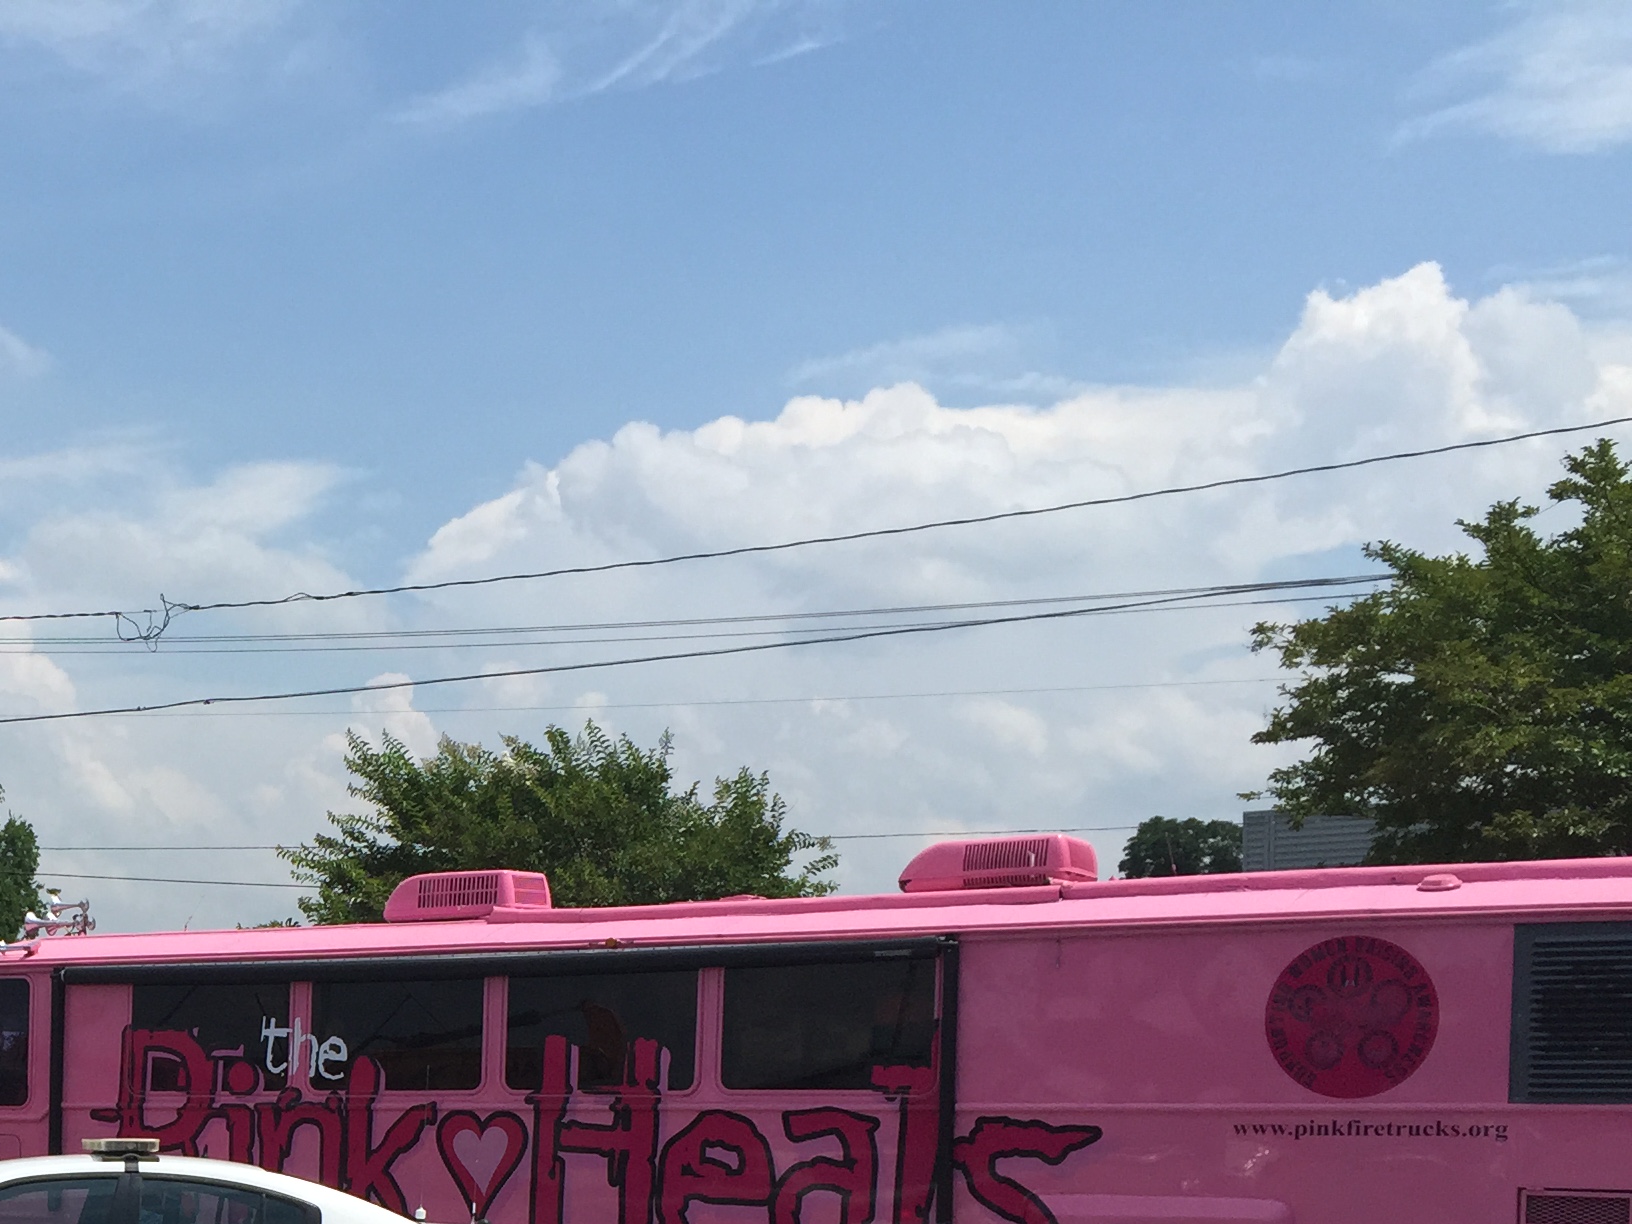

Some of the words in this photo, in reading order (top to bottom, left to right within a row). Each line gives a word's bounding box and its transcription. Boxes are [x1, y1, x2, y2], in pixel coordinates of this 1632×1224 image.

[261, 1016, 348, 1081] the
[92, 1026, 438, 1218] Pink
[1233, 1119, 1509, 1142] www.pinkfiretrucks.org
